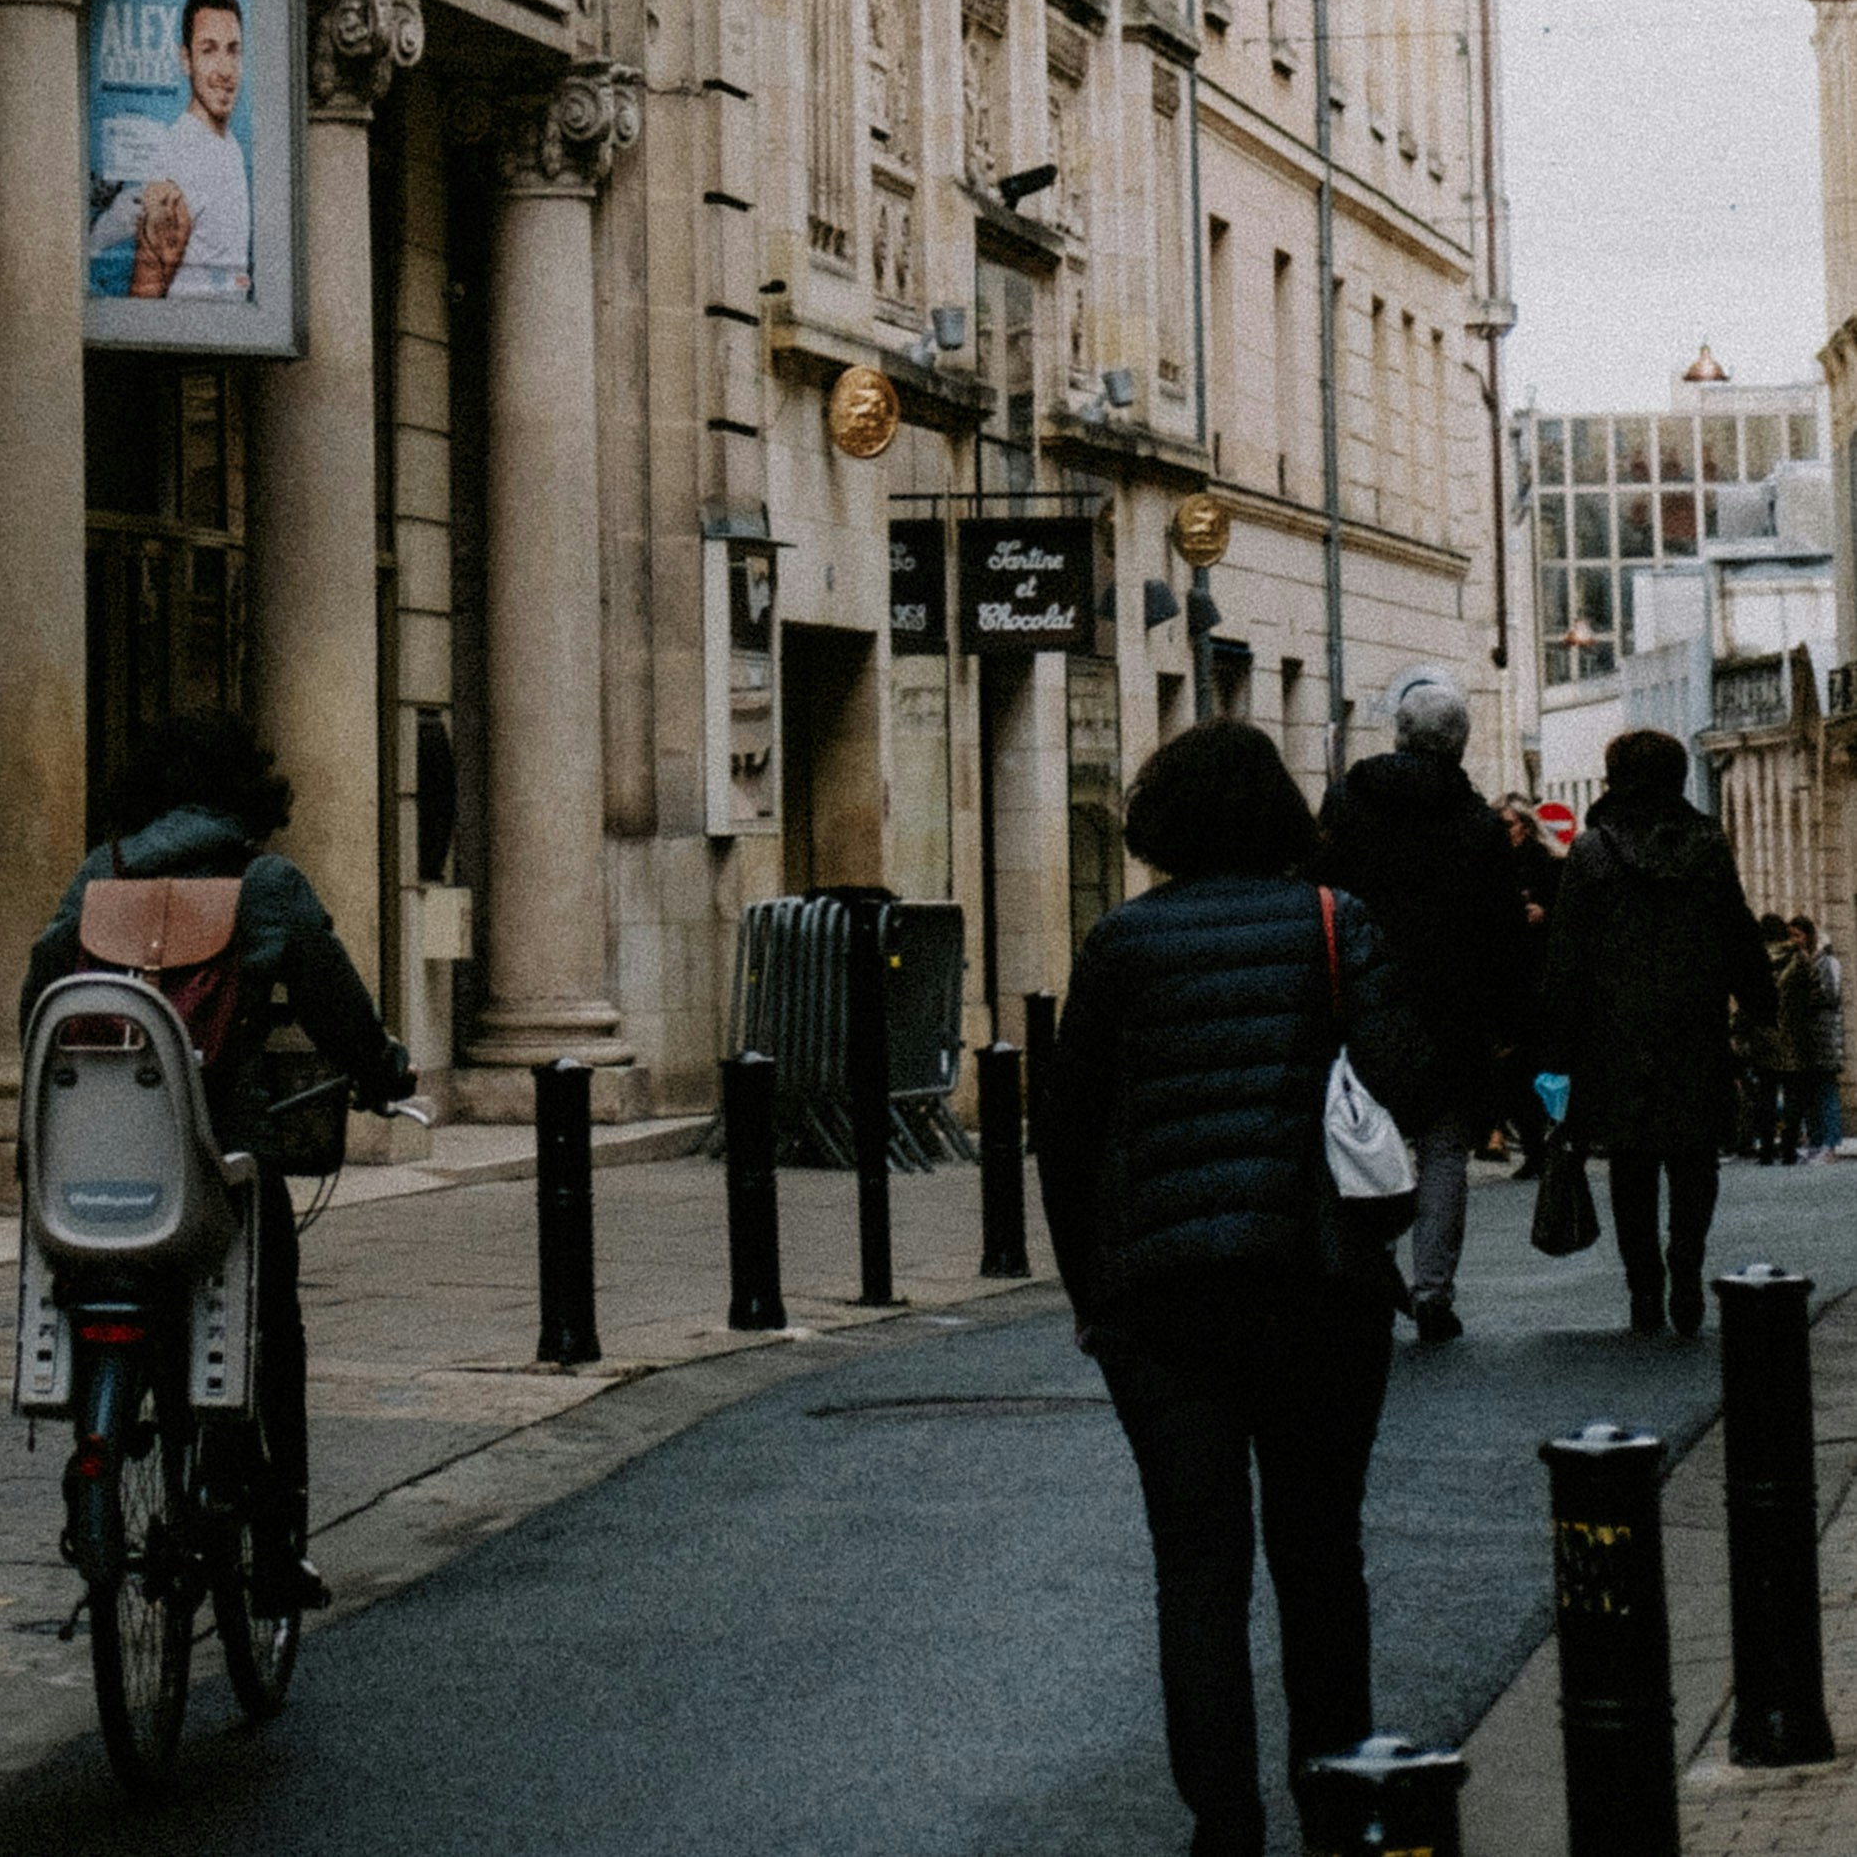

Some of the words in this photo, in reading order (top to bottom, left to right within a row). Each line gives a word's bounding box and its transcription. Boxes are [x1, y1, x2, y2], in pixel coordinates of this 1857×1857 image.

[100, 2, 180, 57] ALEX
[988, 540, 1065, 571] Tartine
[1015, 575, 1038, 599] et
[978, 602, 1076, 631] Chocolat
